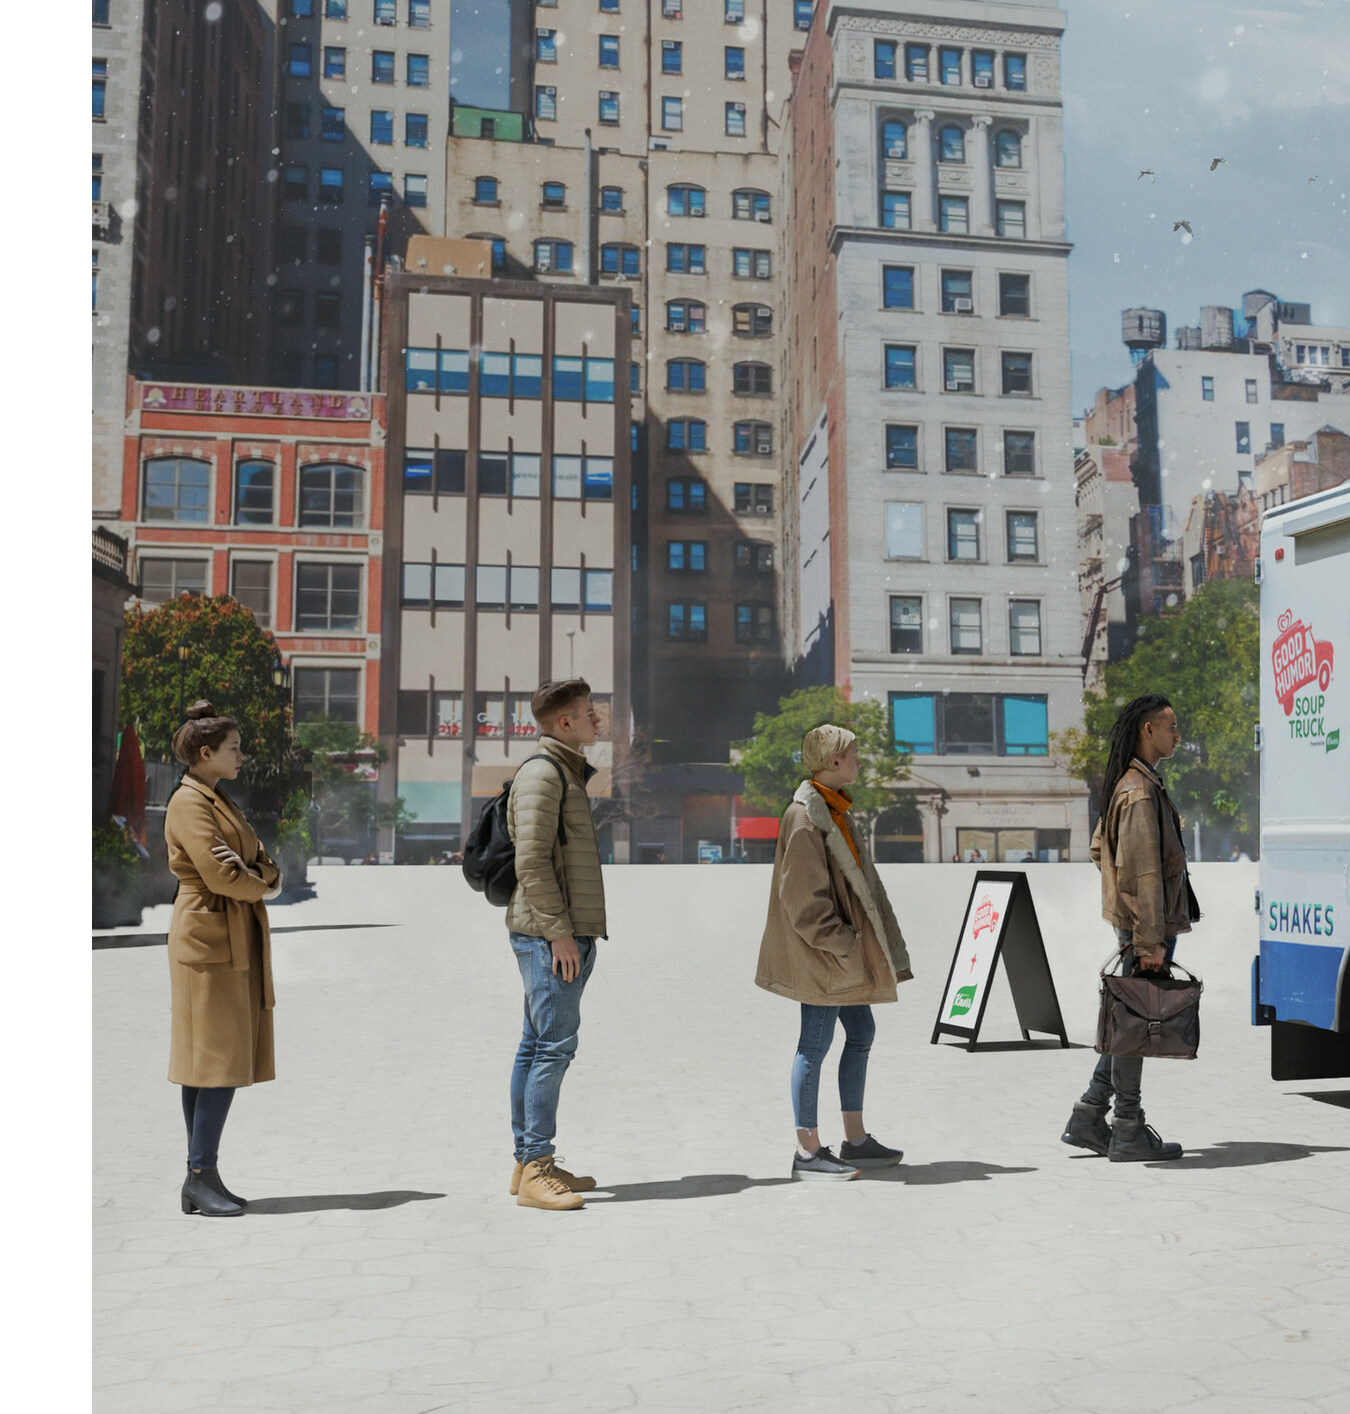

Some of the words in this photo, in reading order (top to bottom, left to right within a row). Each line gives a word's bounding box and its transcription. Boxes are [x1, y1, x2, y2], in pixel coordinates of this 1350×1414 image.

[171, 386, 343, 408] HEARTLAND
[1274, 631, 1303, 674] GOOD
[1276, 652, 1313, 698] HUMOR
[1295, 694, 1325, 716] SOUP
[1288, 717, 1325, 739] TRUCK
[1268, 901, 1334, 936] SHAKES
